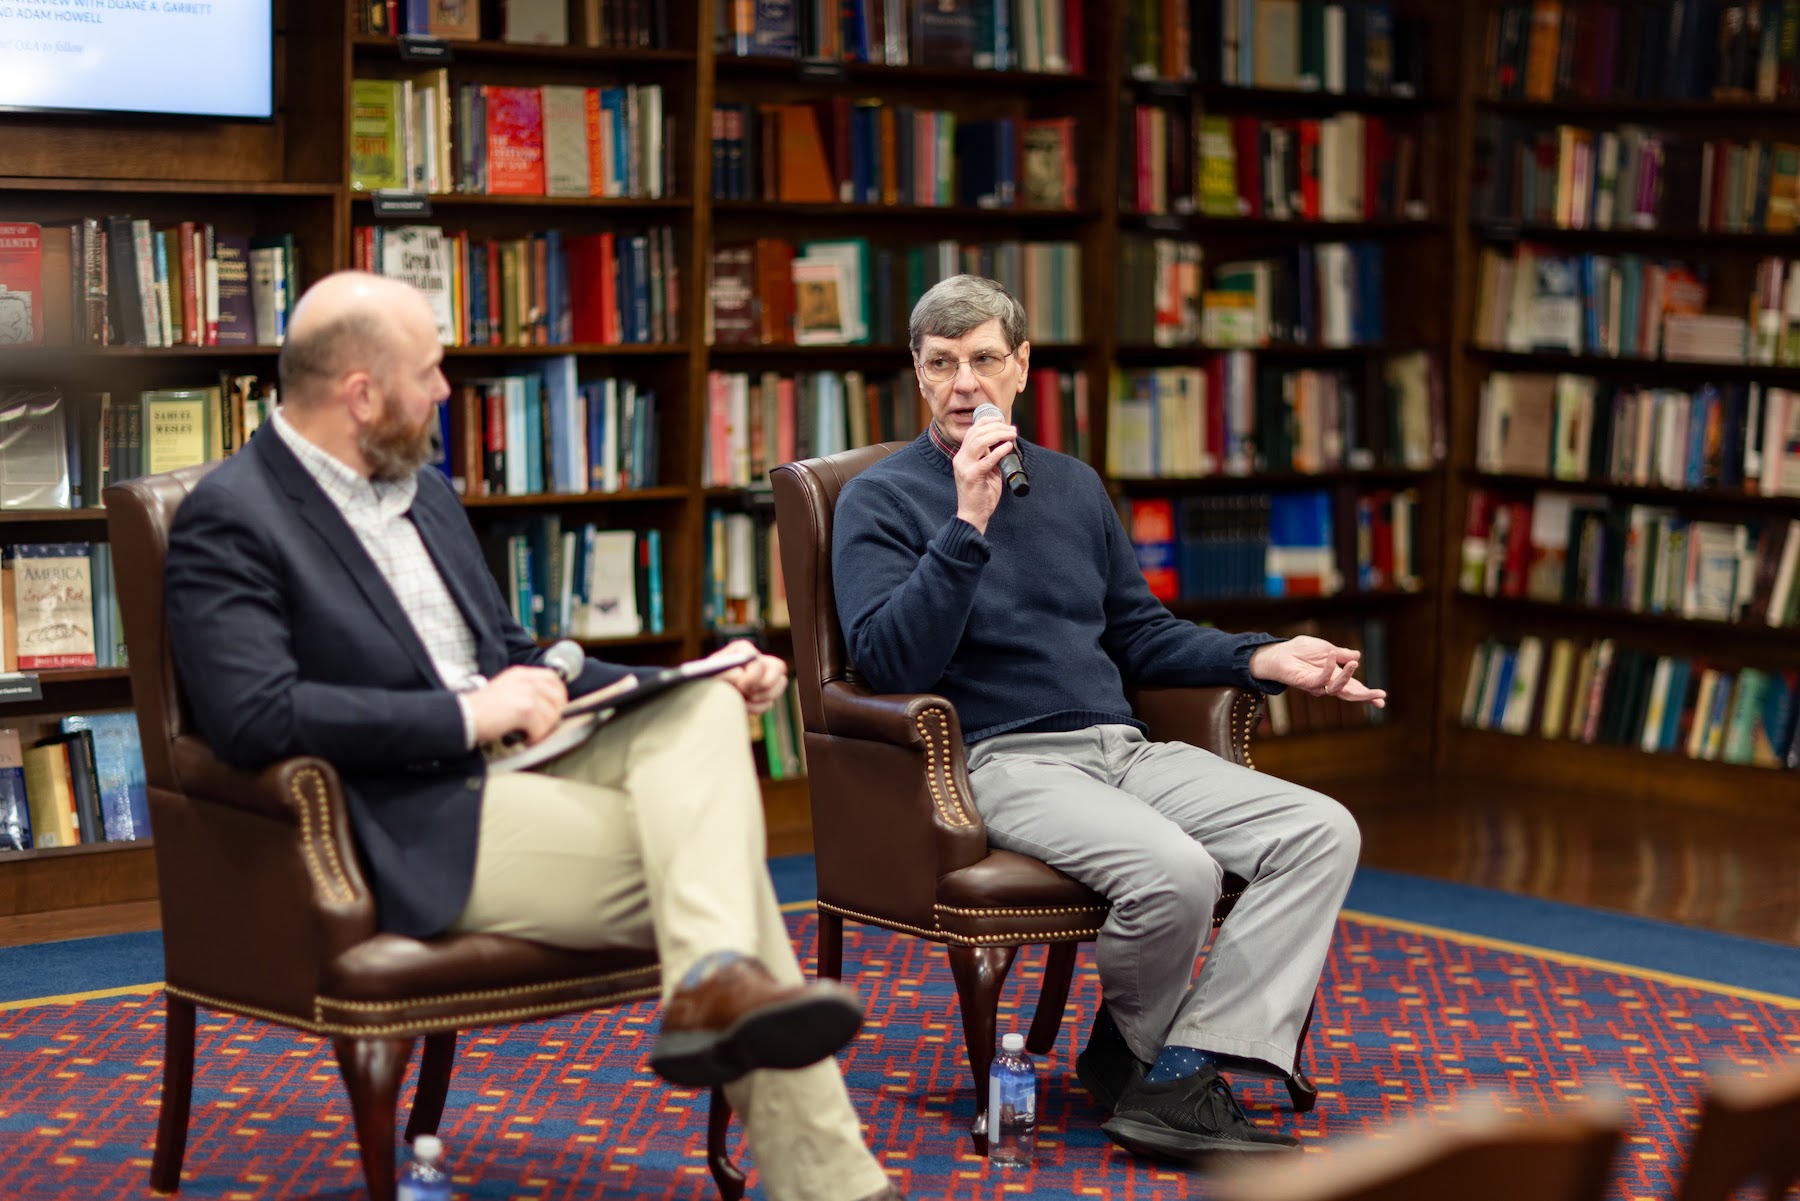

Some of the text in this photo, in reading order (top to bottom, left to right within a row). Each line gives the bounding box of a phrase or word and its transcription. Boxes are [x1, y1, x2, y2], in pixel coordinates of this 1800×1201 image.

[74, 0, 104, 9] WITH
[107, 0, 147, 11] DUANE
[163, 2, 213, 16] GARRETT
[16, 9, 50, 20] ADAM
[55, 10, 104, 24] HOWELL
[154, 411, 191, 421] SAMUEL
[155, 424, 192, 435] WESLEY
[25, 567, 83, 580] AMERICA
